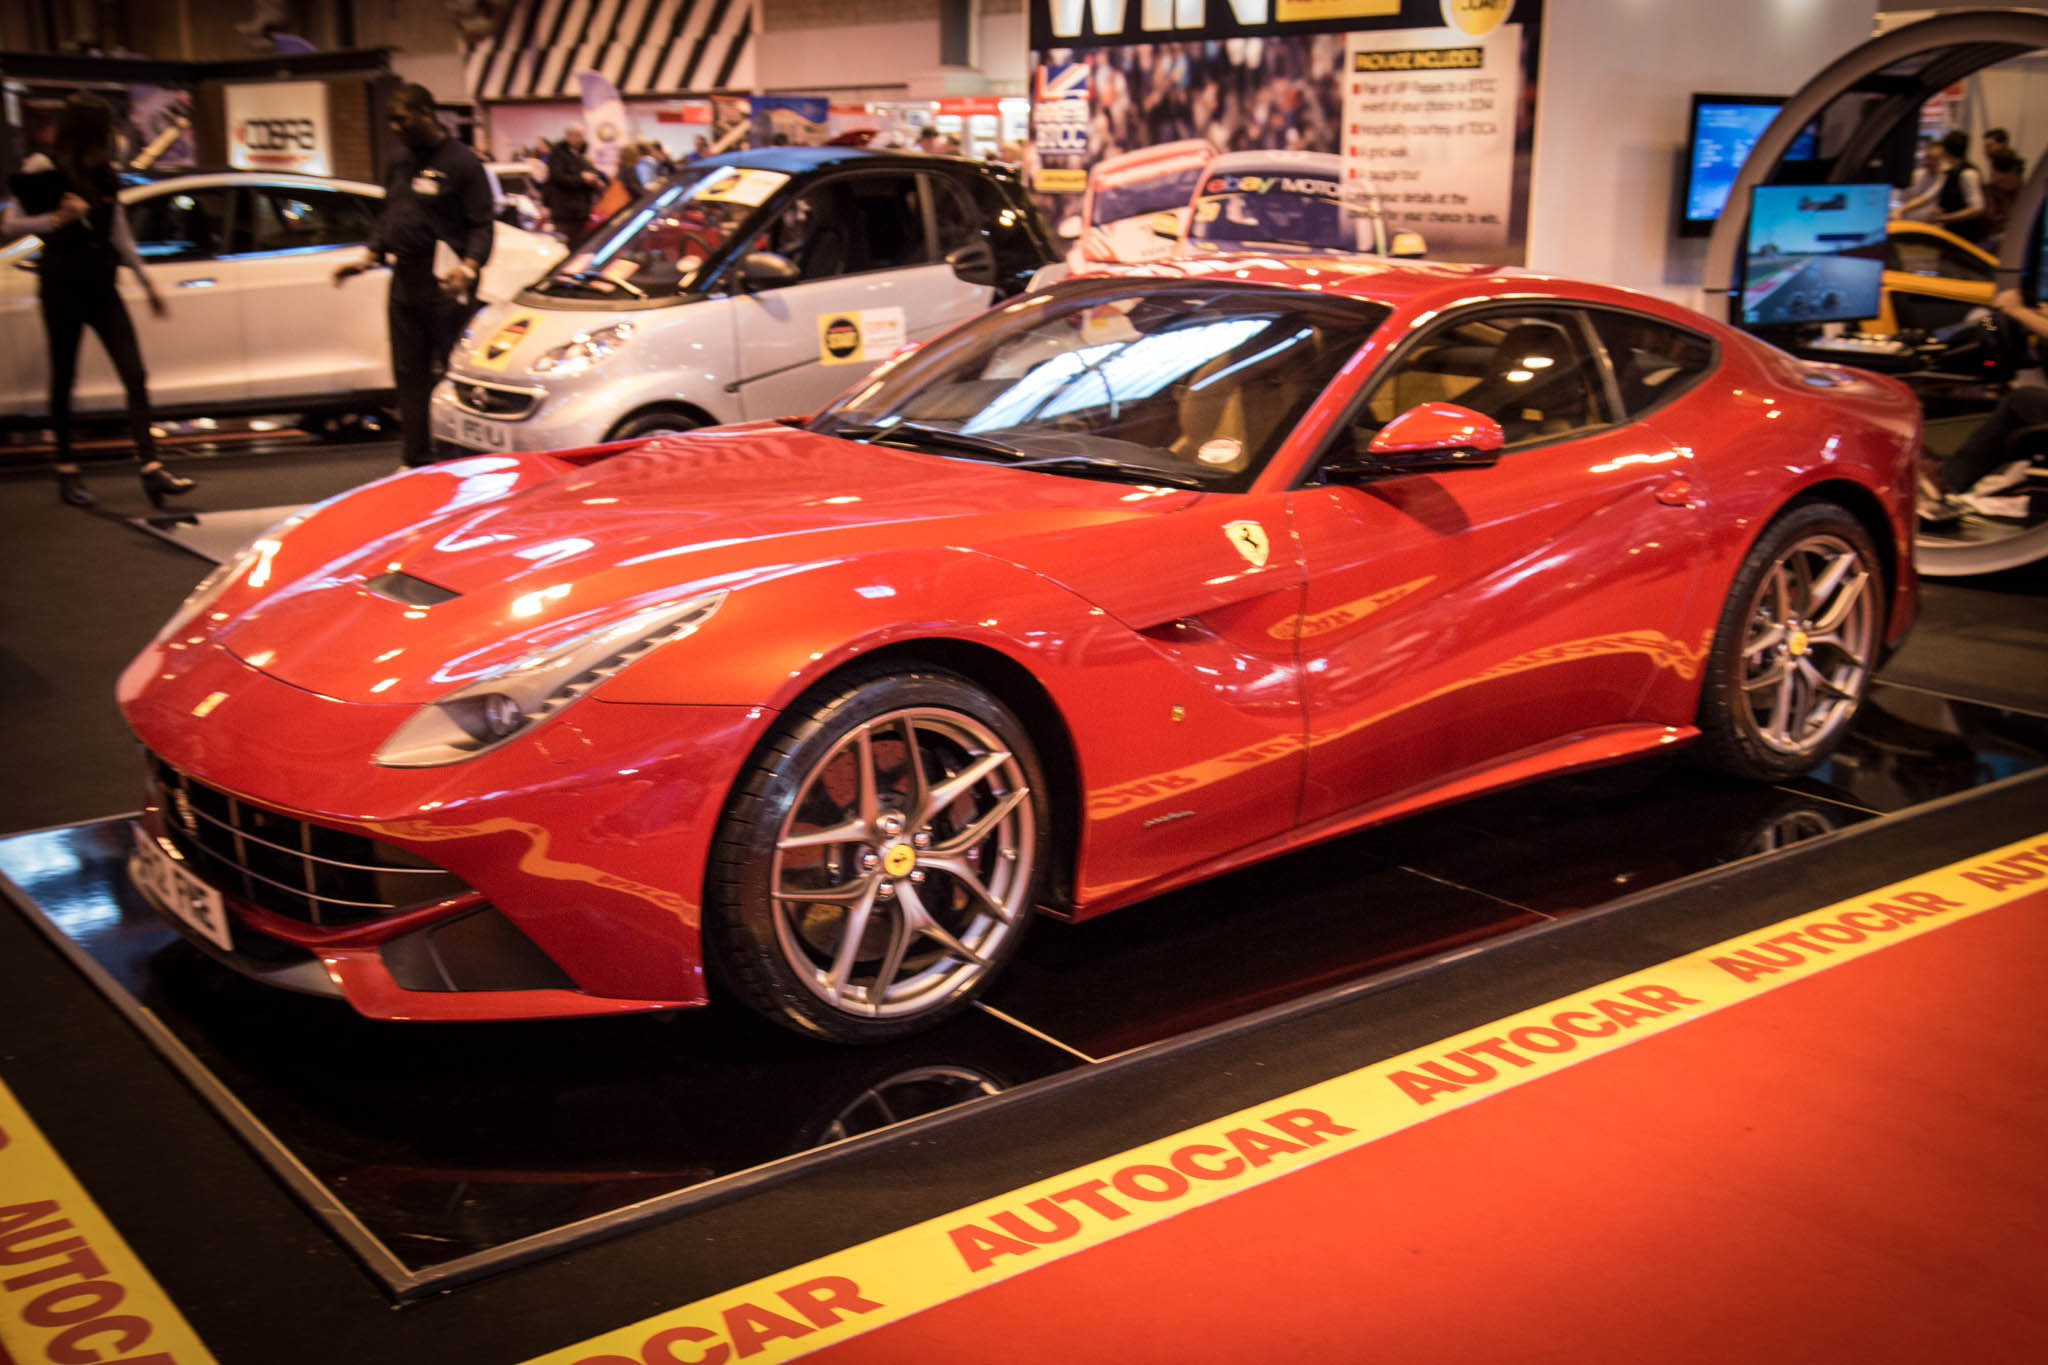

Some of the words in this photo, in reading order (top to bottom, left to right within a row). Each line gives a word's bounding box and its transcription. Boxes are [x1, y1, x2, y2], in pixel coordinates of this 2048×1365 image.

[1711, 891, 1967, 984] AUTOCAR
[1387, 985, 1700, 1106] AUTOCAR
[948, 1109, 1356, 1273] AUTOCAR
[0, 1199, 177, 1365] AUTOC
[572, 1276, 885, 1365] CAR
